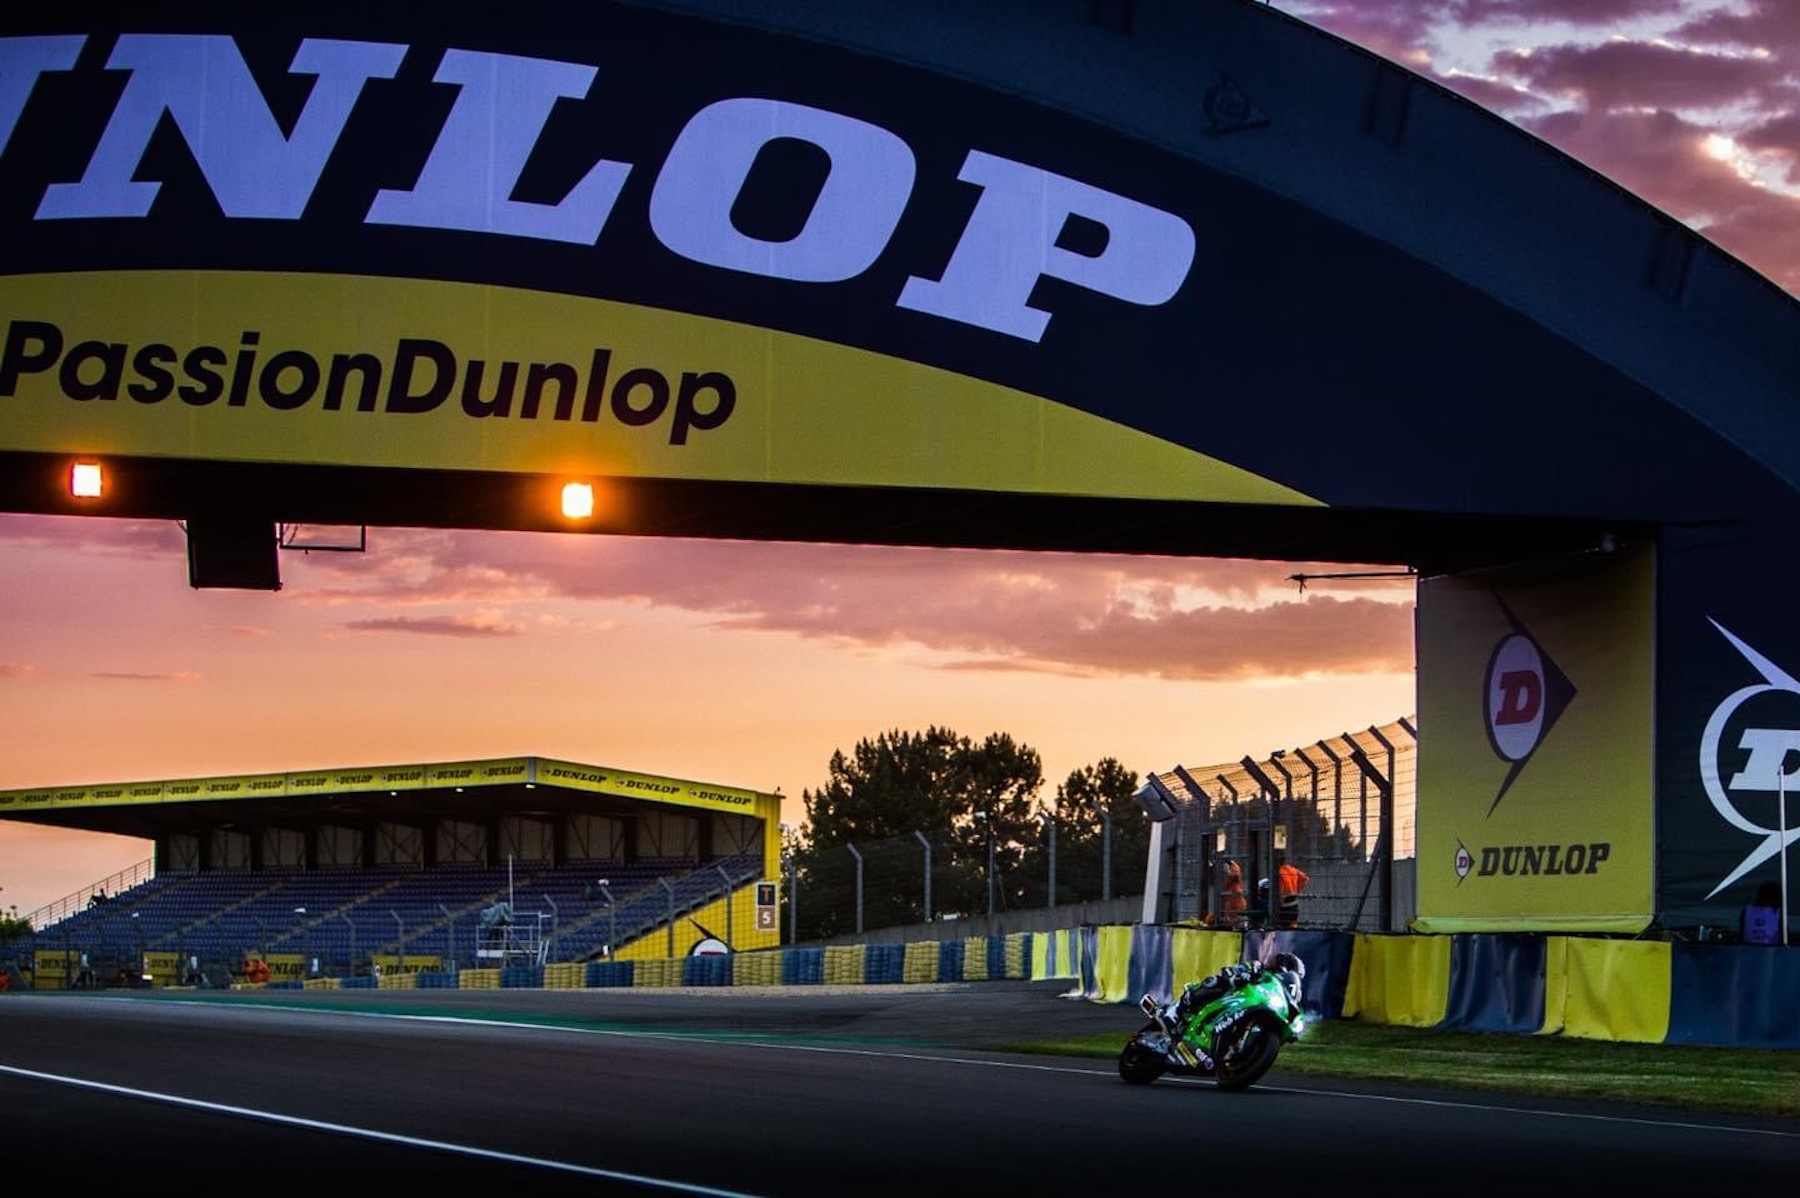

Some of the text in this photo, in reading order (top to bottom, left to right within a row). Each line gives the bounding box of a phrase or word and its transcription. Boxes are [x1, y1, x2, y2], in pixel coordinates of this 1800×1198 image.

[0, 320, 736, 445] PassionDunlop
[1494, 670, 1541, 725] D
[387, 772, 421, 782] DUNLOP
[437, 769, 473, 779] DUNLOP
[487, 766, 525, 776] DUNLOP
[552, 768, 751, 805] DUNLOP DUNLOP DUNLOP
[1477, 843, 1611, 876] DUNLOP
